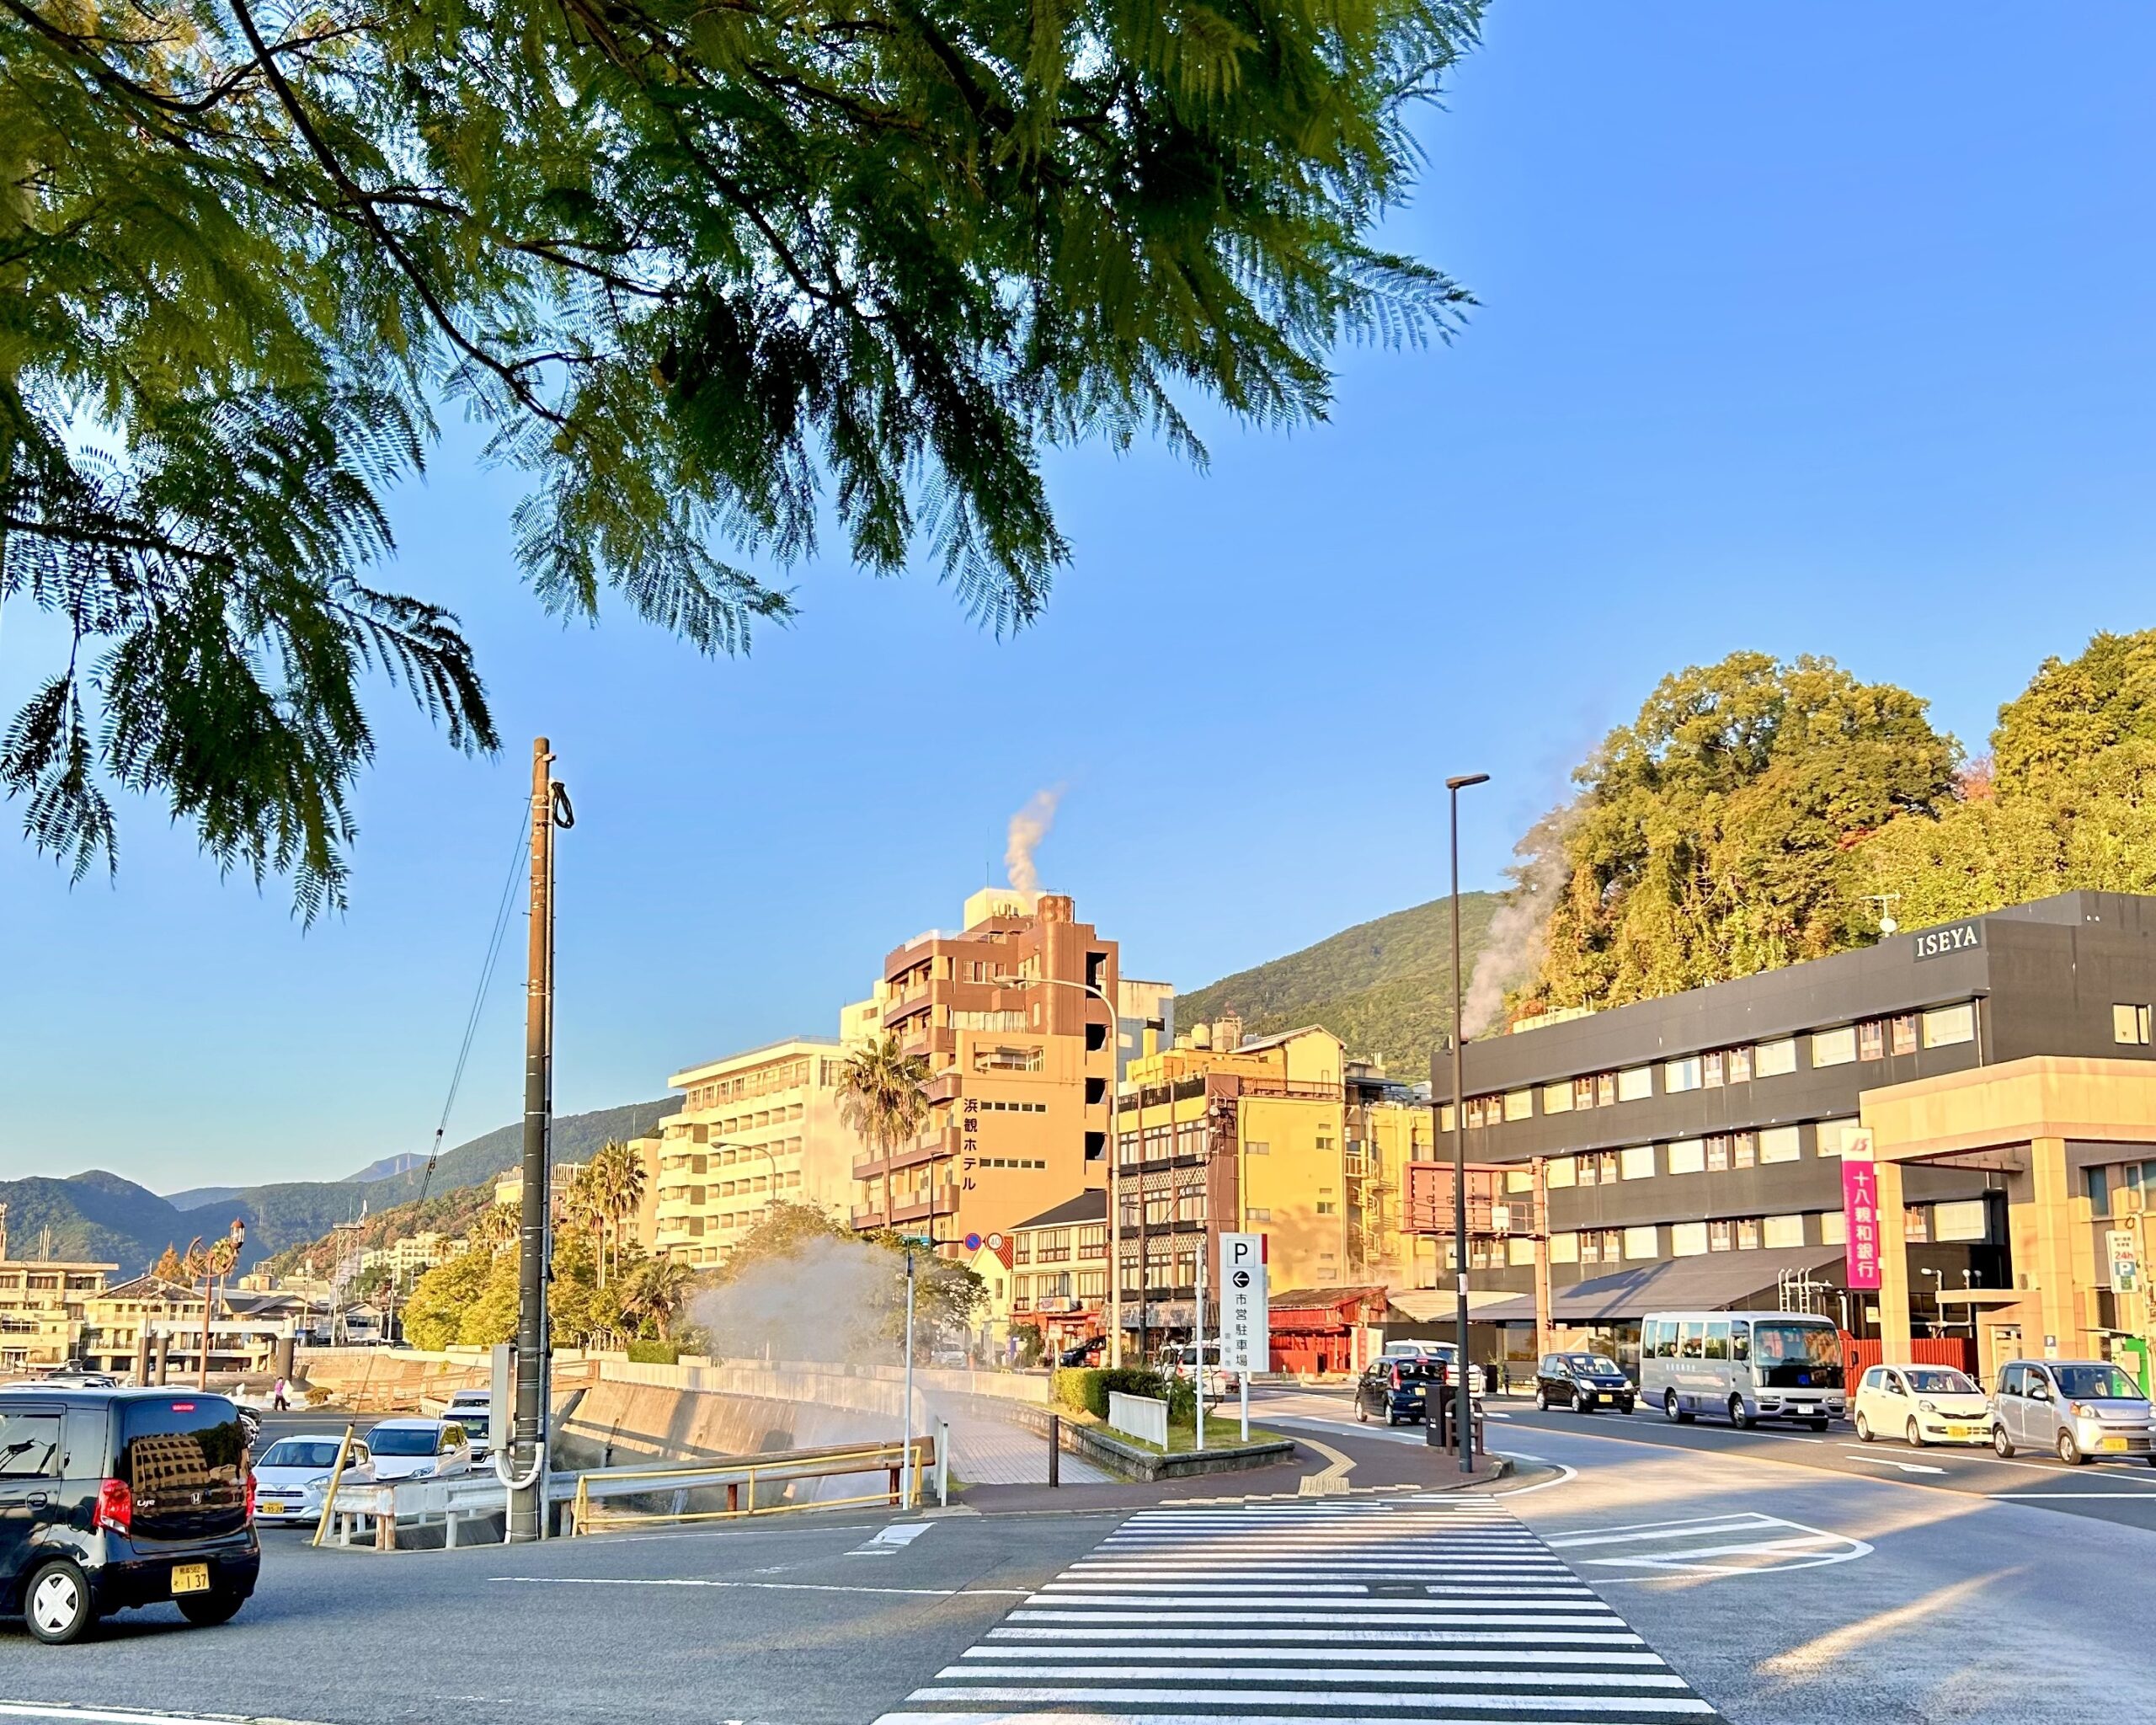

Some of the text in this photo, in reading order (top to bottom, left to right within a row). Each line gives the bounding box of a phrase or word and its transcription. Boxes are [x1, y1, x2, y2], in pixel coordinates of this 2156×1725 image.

[1917, 926, 1977, 957] ISEYA
[963, 1098, 978, 1191] 浜観ホテル
[1853, 1170, 1875, 1279] 十八親和銀行
[990, 1237, 1001, 1246] 40
[1235, 1242, 1248, 1264] P
[2115, 1252, 2133, 1260] 24h
[2119, 1262, 2132, 1276] P
[1235, 1293, 1248, 1367] 市営駐車場
[2047, 1337, 2053, 1346] P
